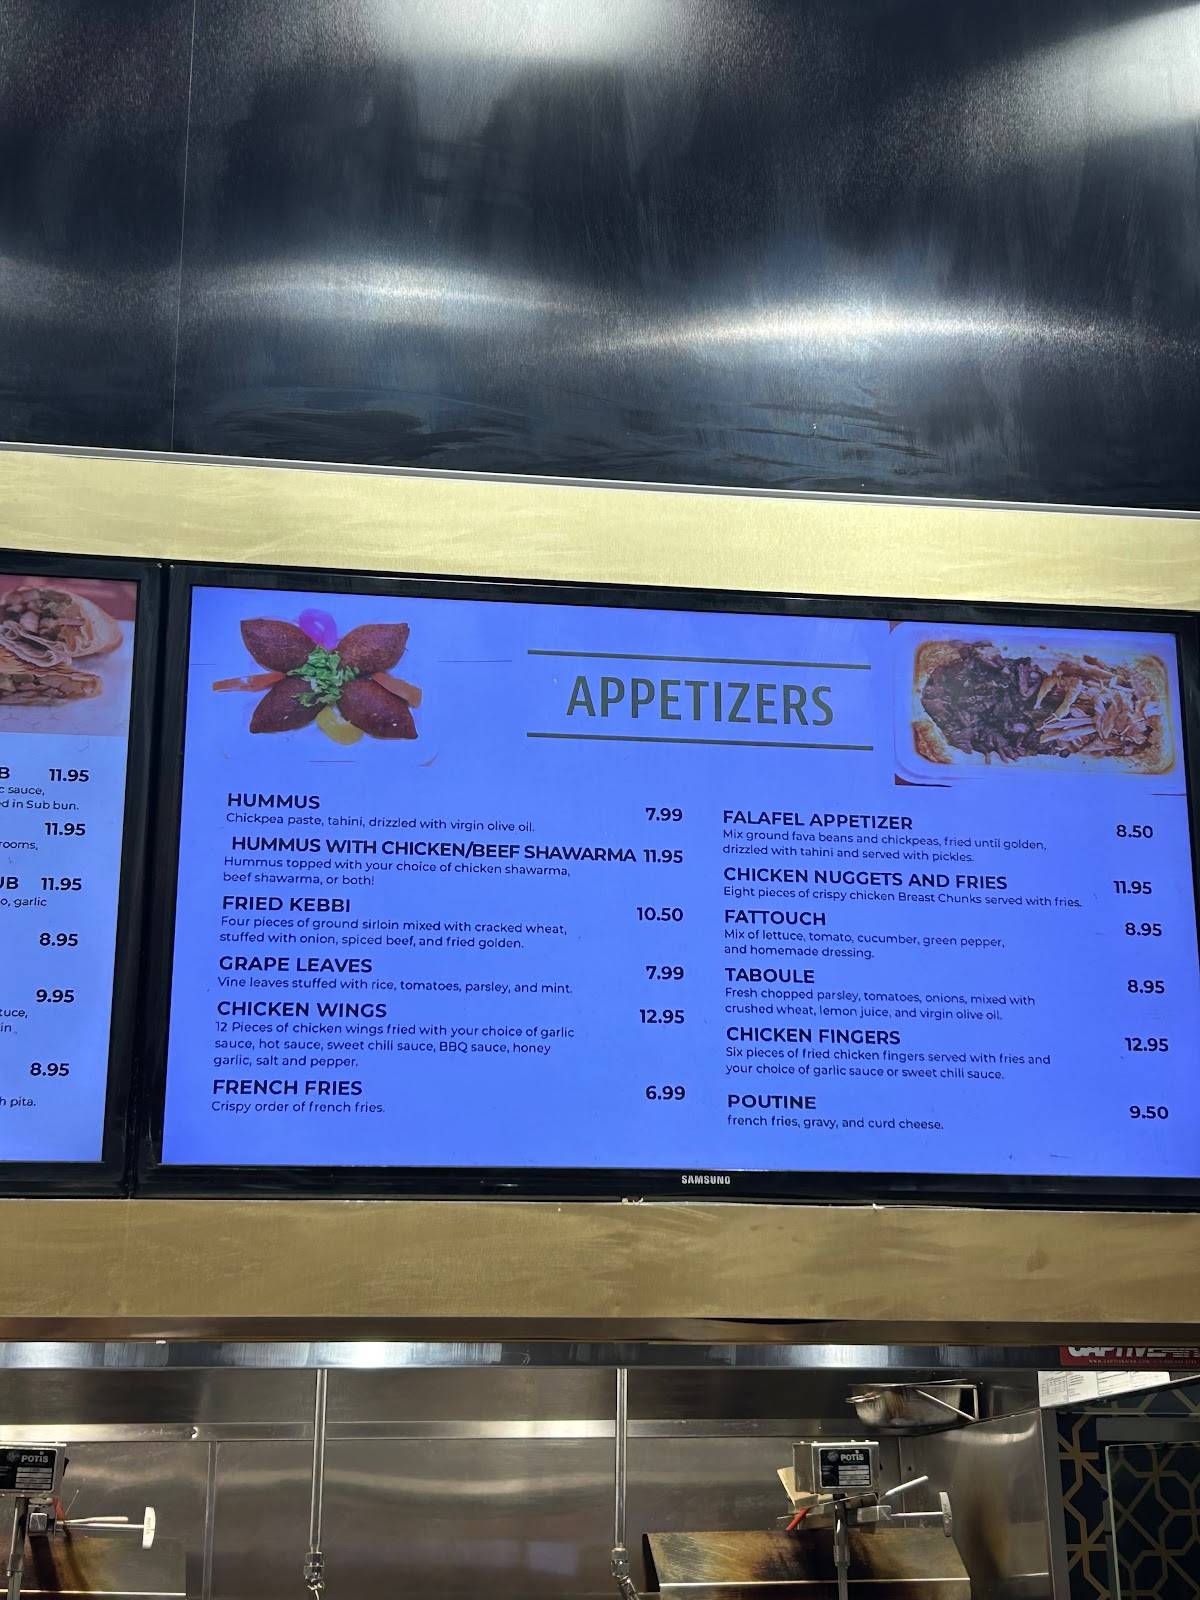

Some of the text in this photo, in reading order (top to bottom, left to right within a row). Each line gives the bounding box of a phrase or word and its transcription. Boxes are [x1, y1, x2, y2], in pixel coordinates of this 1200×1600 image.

[566, 675, 835, 727] APPETIZERS
[48, 768, 90, 783] 11.95
[5, 786, 45, 798] sauce,
[25, 799, 51, 810] Sub
[51, 800, 80, 811] bun.
[227, 792, 321, 810] HUMMUS
[226, 811, 535, 833] Chickpea paste, tahini, drizzled with virgin olive oil.
[645, 807, 683, 822] 7.99
[723, 809, 913, 831] FALAFEL APPETIZER
[44, 822, 86, 837] 11.95
[1116, 824, 1154, 839] 8.50
[231, 836, 684, 864] HUMMUS WITH CHICKEN/BEEF SHAWARMA 11.95
[224, 855, 571, 878] Hummus topped with your choice of chicken shawarma,
[40, 877, 82, 892] 11.95
[222, 871, 375, 886] beef shawarma, or both!
[723, 866, 1008, 890] CHICKEN NUGGETS AND FRIES
[723, 884, 1083, 908] Eight pieces of crispy chicken Breast Chunks served with fries.
[1112, 880, 1153, 895] 11.95
[13, 896, 48, 908] garlic
[222, 895, 351, 913] FRIED KEBBI
[636, 906, 684, 922] 10.50
[724, 909, 826, 926] FATTOUCH
[221, 915, 567, 936] Four pieces of ground sirloin mixed with cracked wheat,
[1124, 921, 1163, 937] 8.95
[39, 932, 79, 947] 8.95
[724, 928, 1005, 949] Mix of lettuce, tomato, cucumber, green pepper,
[724, 943, 875, 960] and homemade dressing.
[219, 955, 373, 974] GRAPE LEAVES
[645, 965, 685, 981] 7.99
[724, 967, 815, 984] TABOULE
[217, 975, 573, 995] Vine leaves stuffed with rice, tomatoes, parsley, and mint.
[1127, 979, 1166, 995] 8.95
[35, 988, 75, 1004] 9.95
[725, 986, 1036, 1006] Fresh chopped parsley, tomatoes, onions, mixed with
[216, 1000, 388, 1019] CHICKEN WINGS
[639, 1008, 685, 1025] 12.95
[215, 1020, 575, 1040] 12 Pieces of chicken wings fried with your choice of garlic
[726, 1026, 901, 1046] CHICKEN FINGERS
[1124, 1037, 1169, 1053] 12.95
[725, 1045, 1051, 1065] Six pieces of fried chicken fingers served with fries and
[29, 1062, 70, 1077] 8.95
[212, 1079, 363, 1096] FRENCH FRIES
[645, 1085, 686, 1101] 6.99
[9, 1095, 37, 1109] pita.
[211, 1100, 385, 1115] Crispy order of french fries.
[727, 1094, 817, 1110] POUTINE
[1129, 1105, 1169, 1120] 9.50
[727, 1113, 944, 1130] french fries, gravy, and curd cheese.
